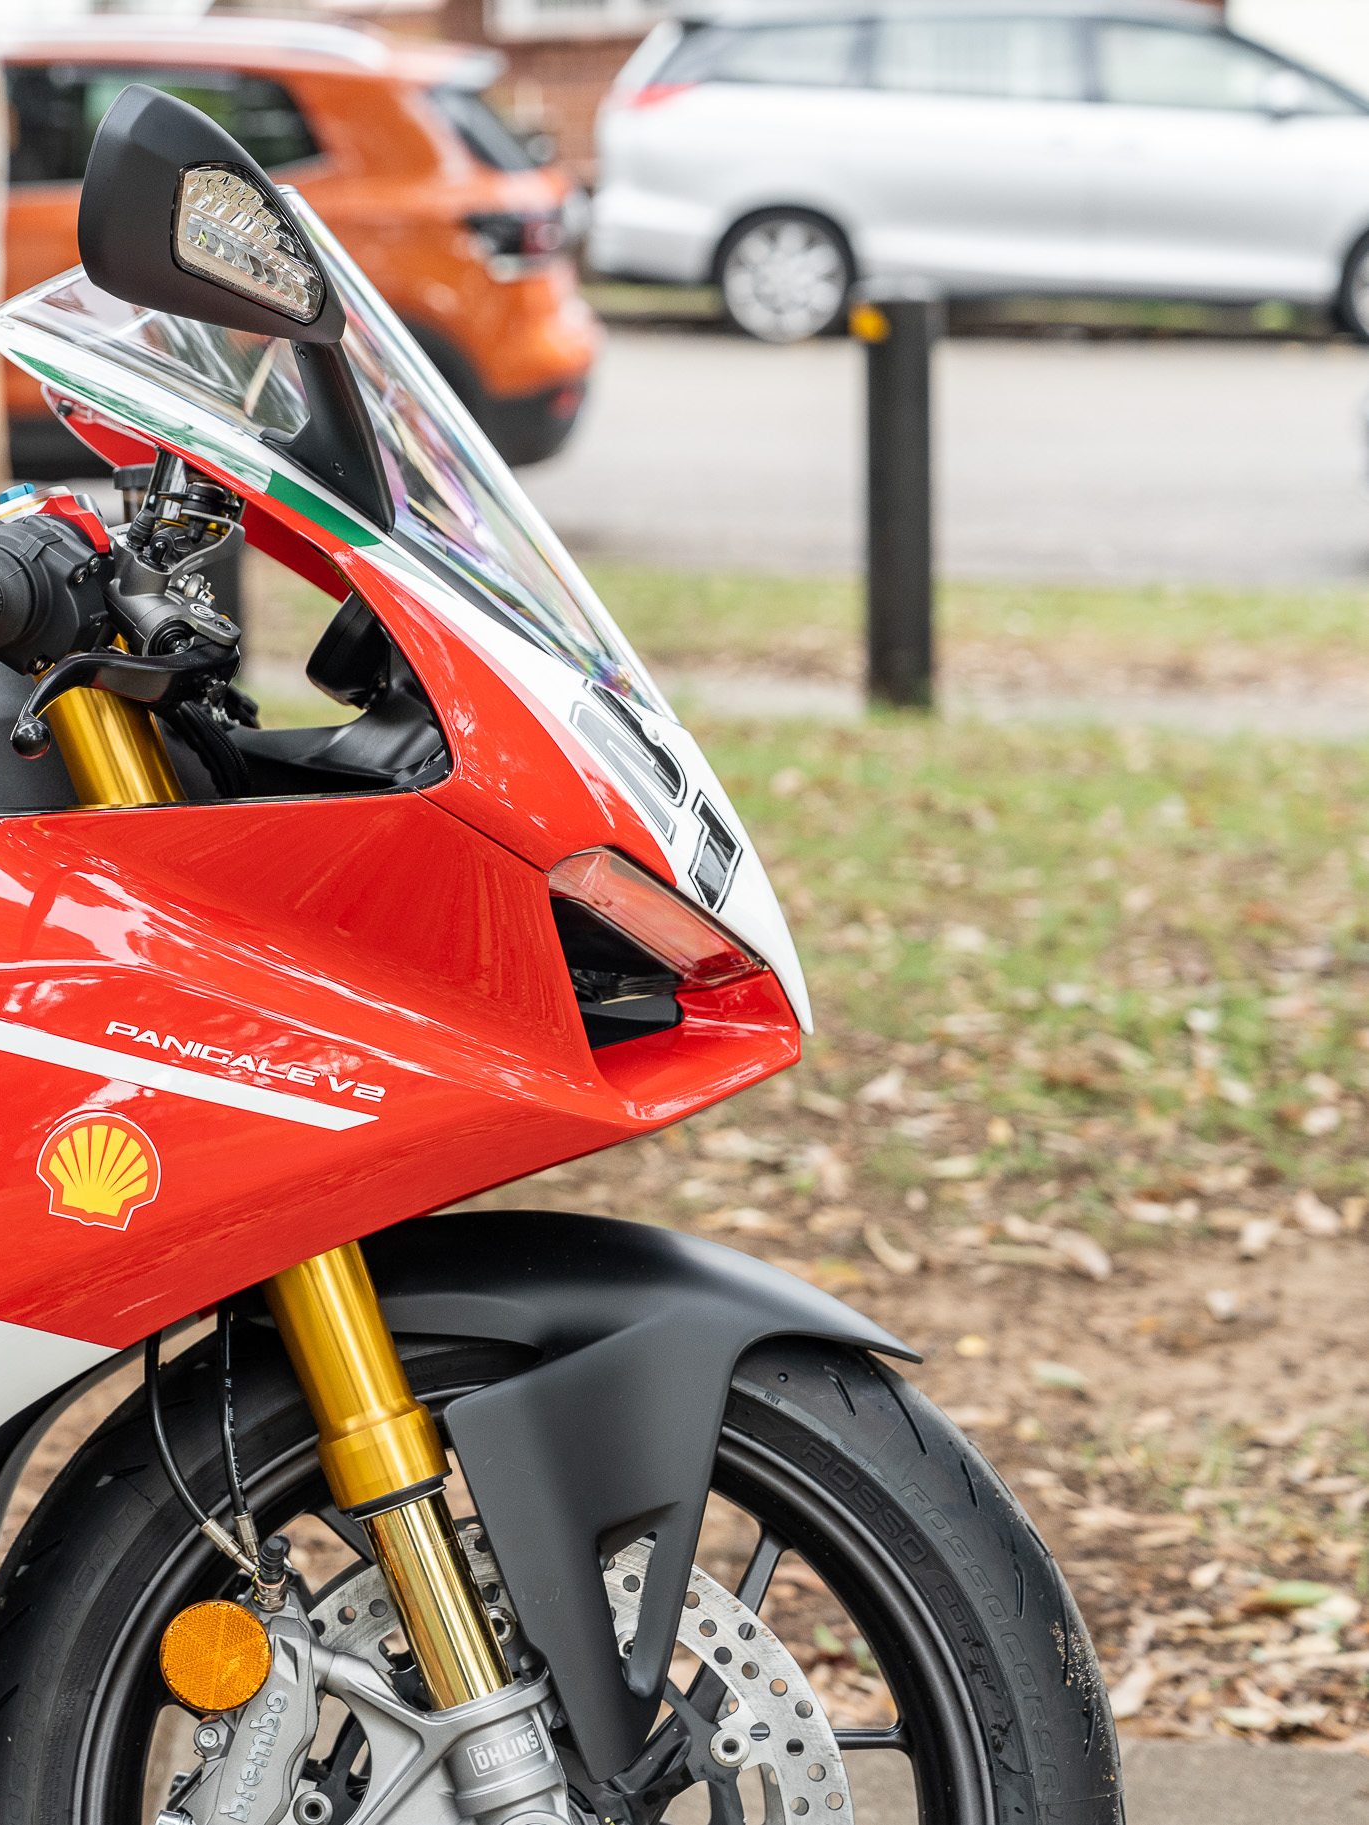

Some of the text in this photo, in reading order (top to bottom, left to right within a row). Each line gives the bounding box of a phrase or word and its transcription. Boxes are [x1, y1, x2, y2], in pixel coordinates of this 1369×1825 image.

[105, 1021, 387, 1103] PANIGALE V2
[801, 1440, 927, 1566] ROSSO
[219, 1689, 289, 1823] brembo
[473, 1727, 539, 1770] ÖHLINS
